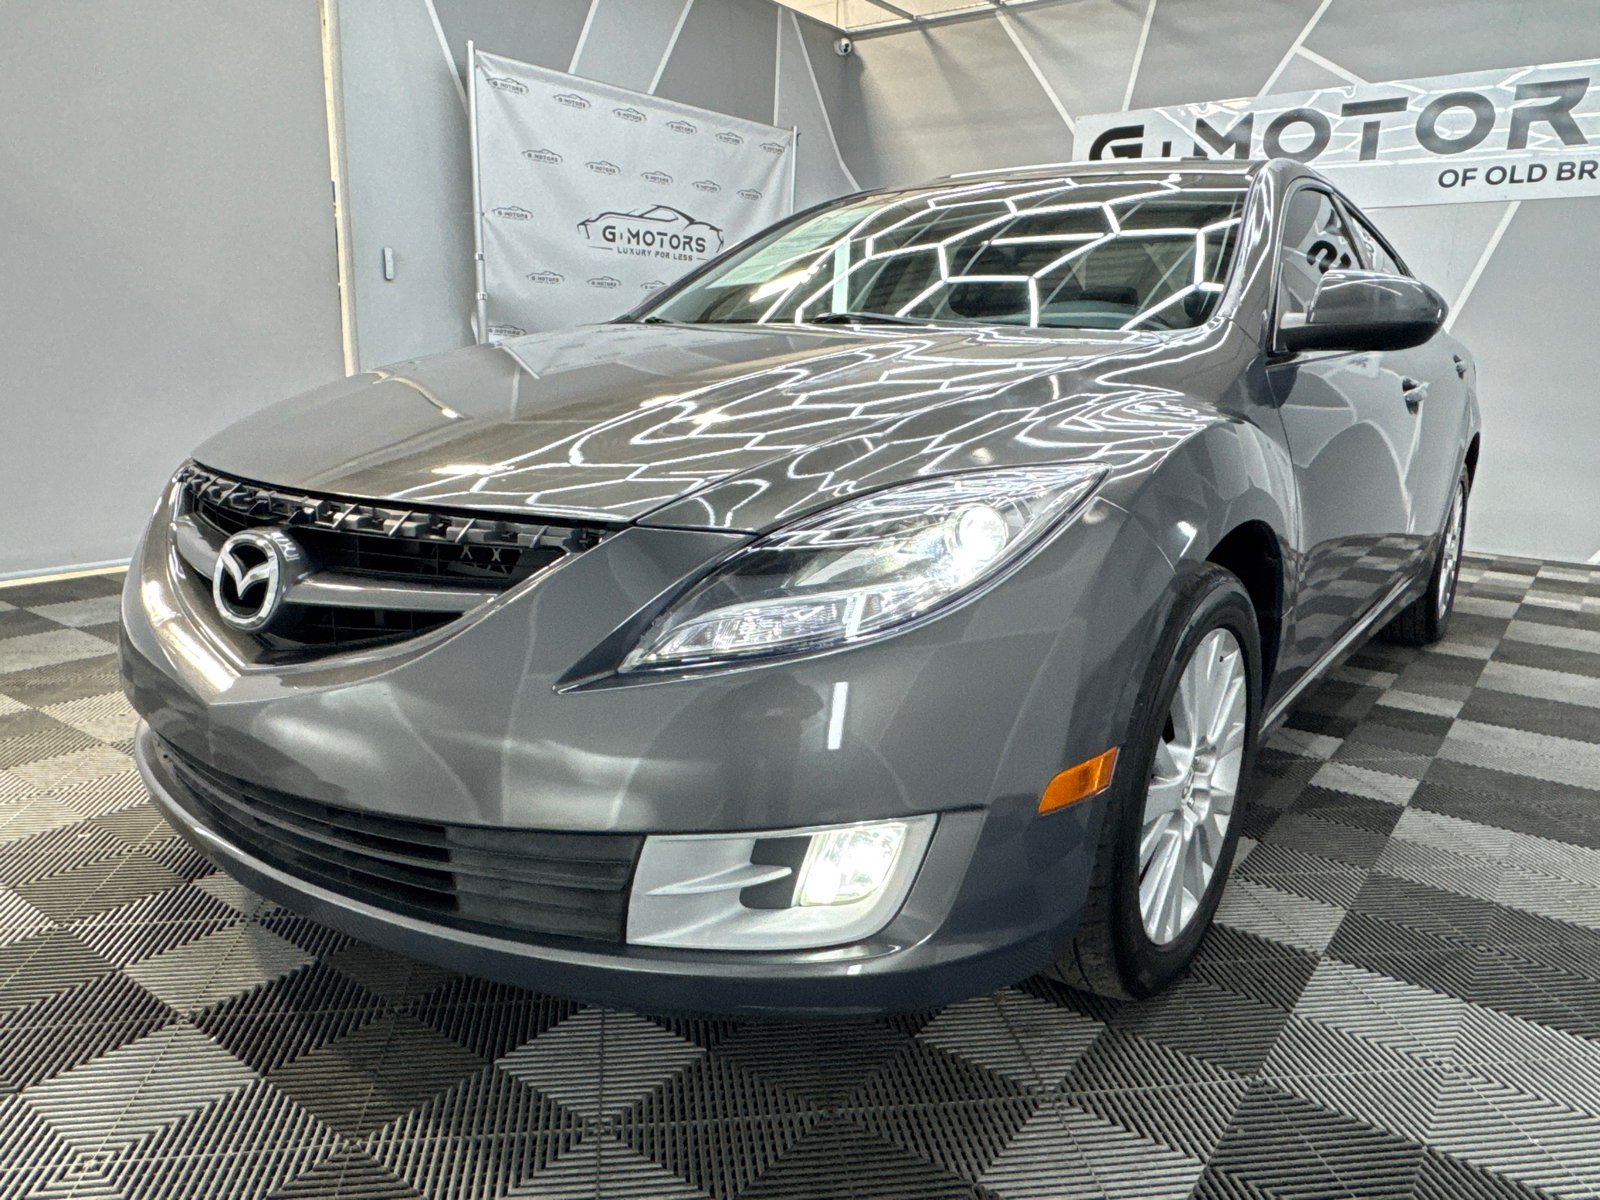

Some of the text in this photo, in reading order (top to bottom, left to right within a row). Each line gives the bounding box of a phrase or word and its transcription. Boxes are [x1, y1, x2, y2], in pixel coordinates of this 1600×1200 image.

[1438, 160, 1599, 188] OF OLD BR
[627, 227, 706, 253] MOTORS
[617, 246, 693, 261] LUXURY FOR LESS
